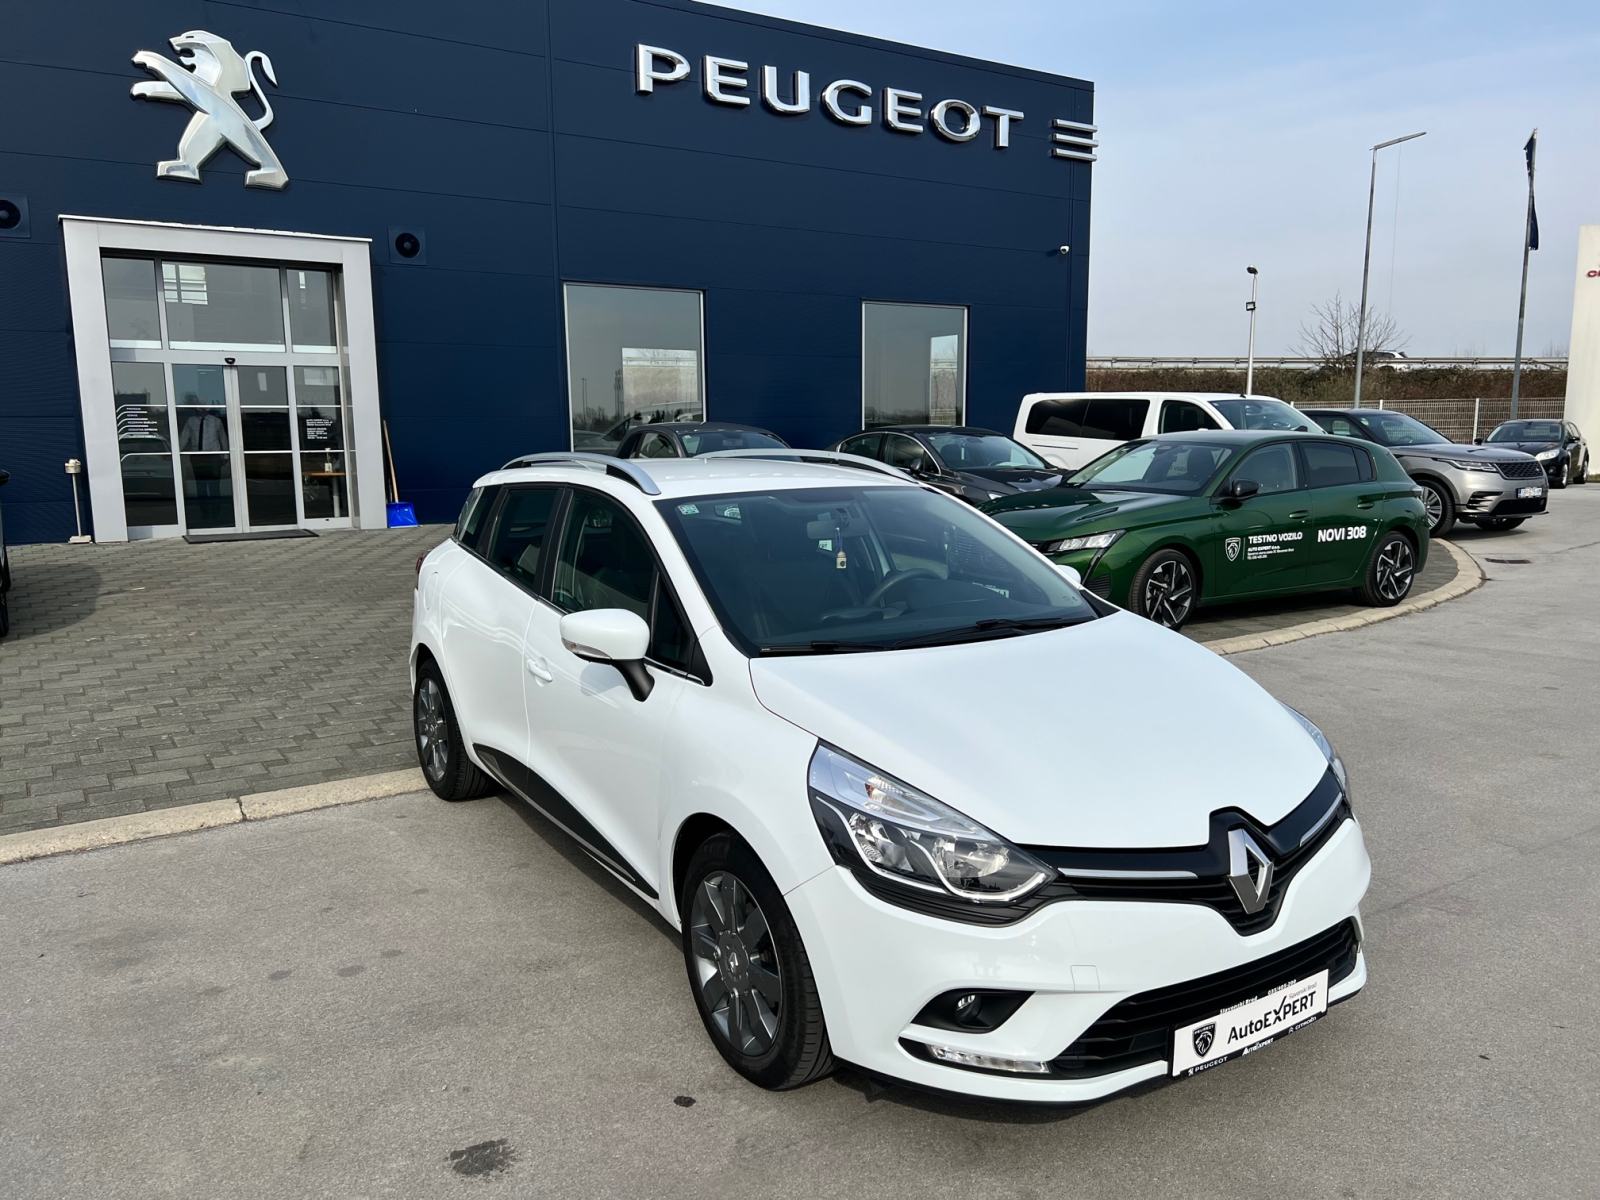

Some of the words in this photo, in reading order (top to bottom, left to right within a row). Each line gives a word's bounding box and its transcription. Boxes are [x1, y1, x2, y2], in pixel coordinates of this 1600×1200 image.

[636, 43, 1025, 150] PEUGEOT
[1248, 534, 1278, 545] TESTNO
[1278, 531, 1303, 542] VOZILO
[1317, 527, 1346, 543] NOVI
[1347, 525, 1367, 540] 308
[1227, 990, 1317, 1044] AutoEXPERT
[1194, 1056, 1228, 1072] PEUGEOT
